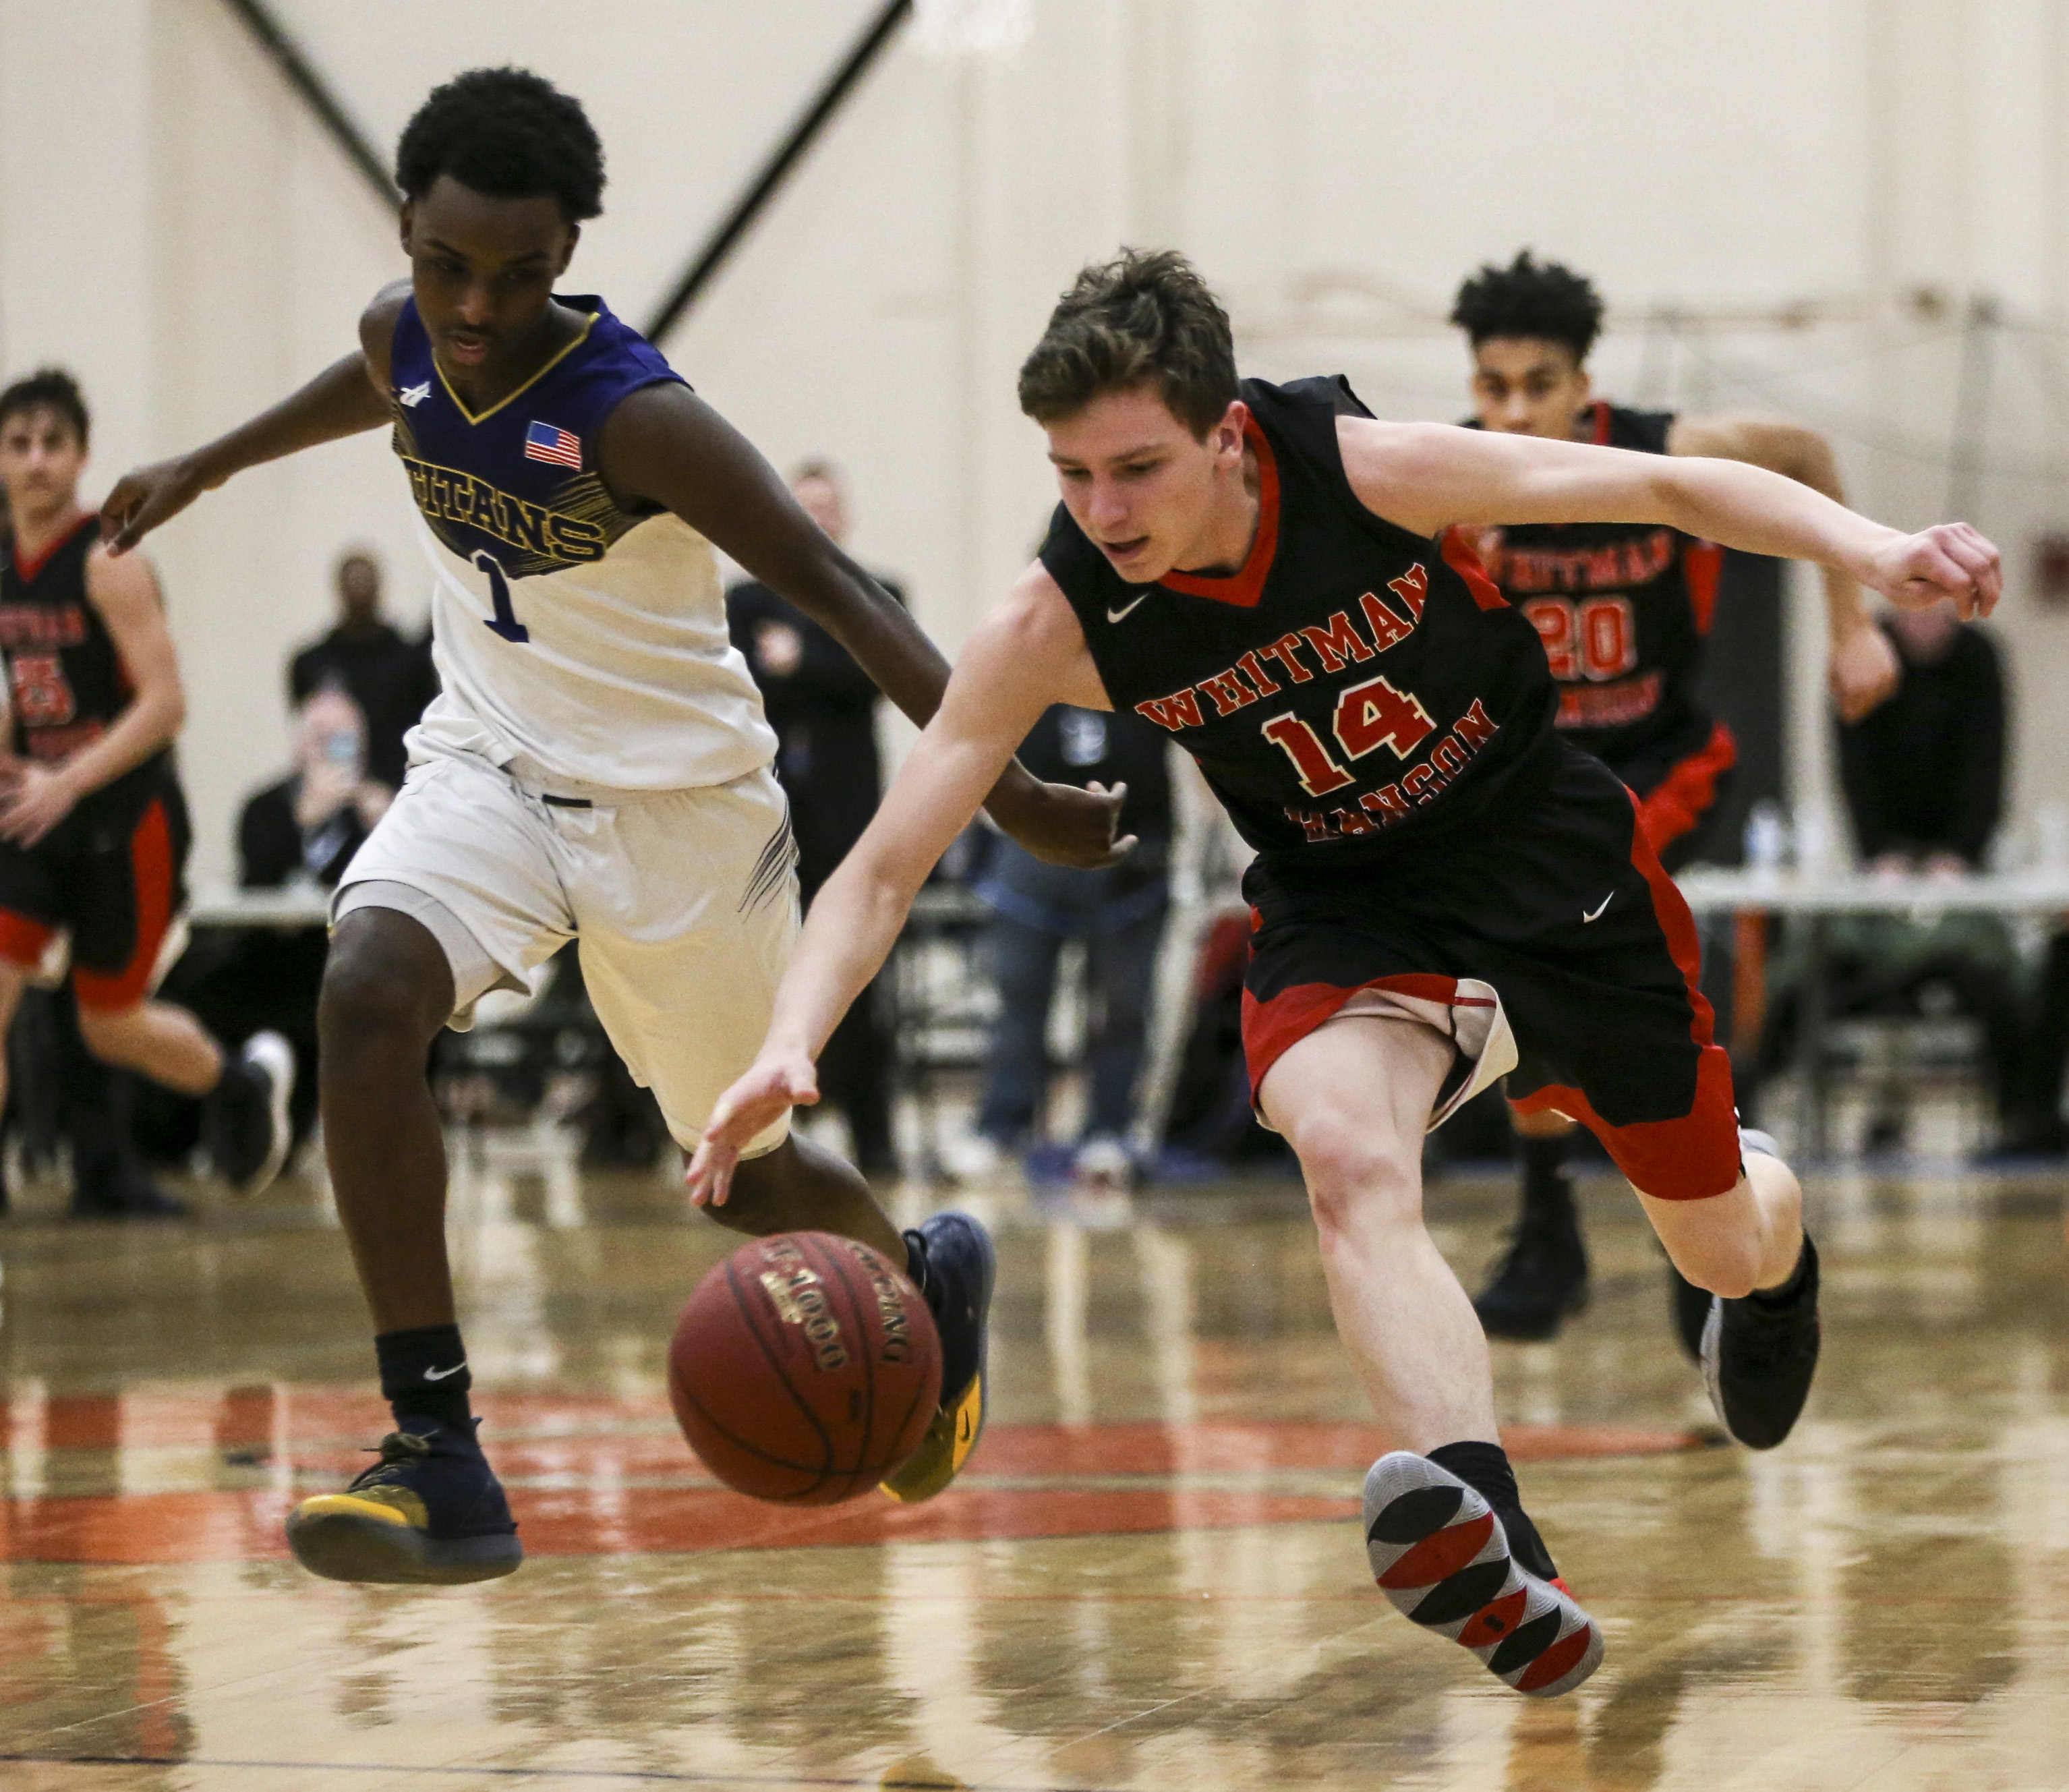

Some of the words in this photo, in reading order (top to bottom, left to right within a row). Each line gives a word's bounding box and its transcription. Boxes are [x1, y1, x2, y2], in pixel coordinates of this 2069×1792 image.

[401, 455, 606, 563] TITANS
[471, 548, 529, 643] 1
[1134, 562, 1428, 732] WHITMAN
[1521, 595, 1637, 681] 20
[1260, 675, 1438, 798] 14
[1283, 697, 1500, 843] HANSON
